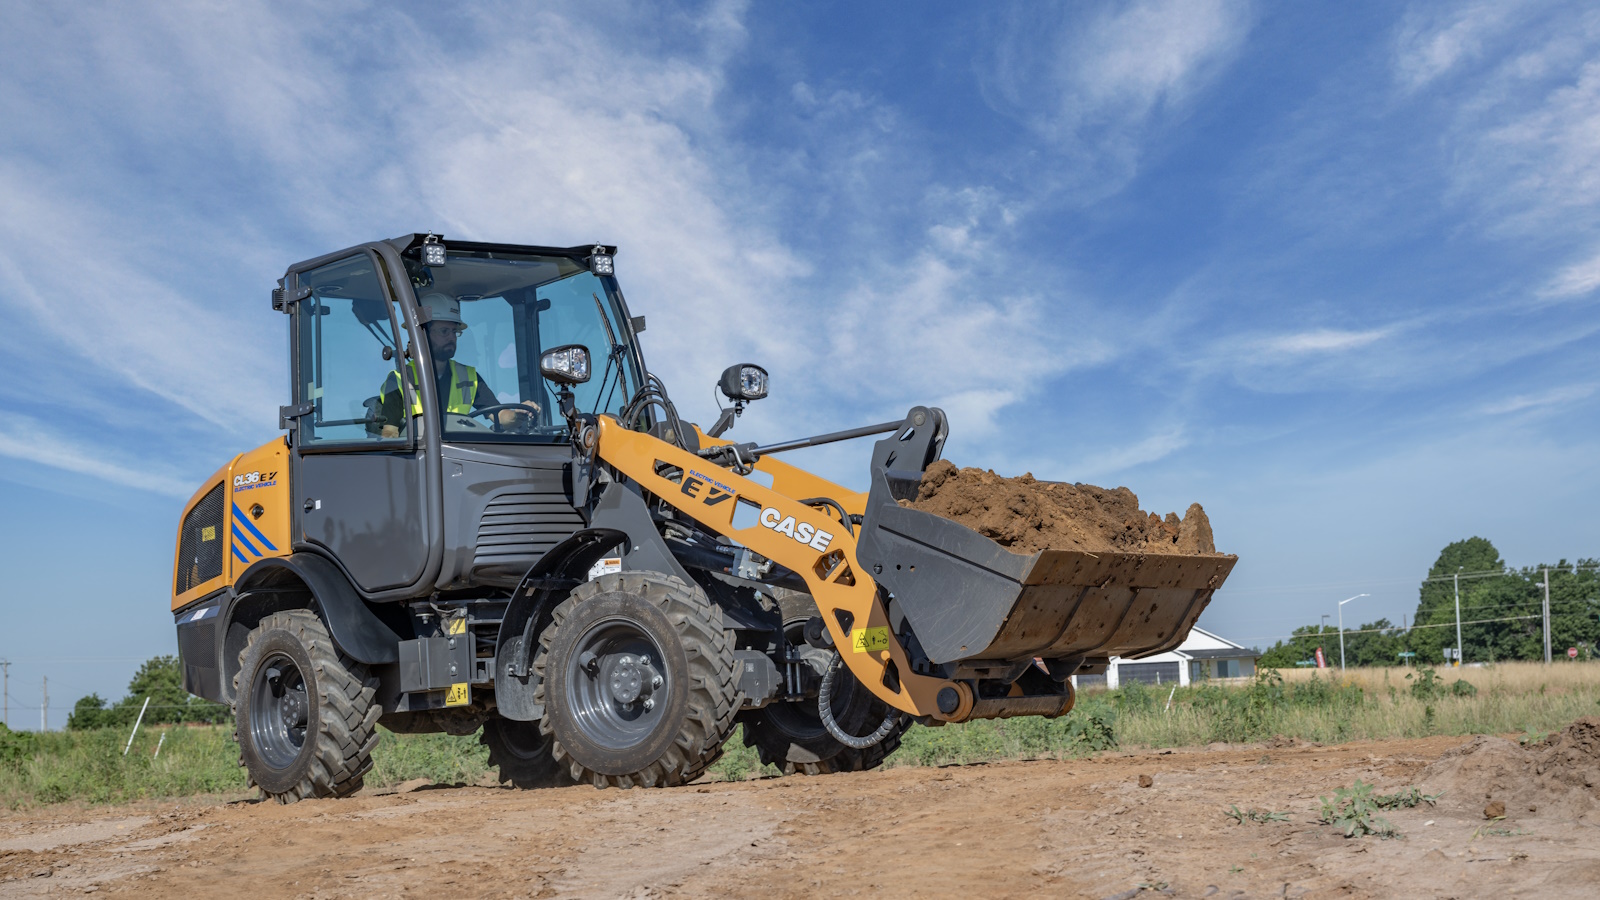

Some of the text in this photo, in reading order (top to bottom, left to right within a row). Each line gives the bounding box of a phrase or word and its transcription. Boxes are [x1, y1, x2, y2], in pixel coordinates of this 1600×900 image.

[234, 472, 260, 486] CL36
[234, 480, 277, 492] ELECTRIC VEHICLE
[681, 477, 732, 506] EV
[689, 469, 736, 495] ELECTRIC VEHICLE
[760, 507, 834, 553] CASE
